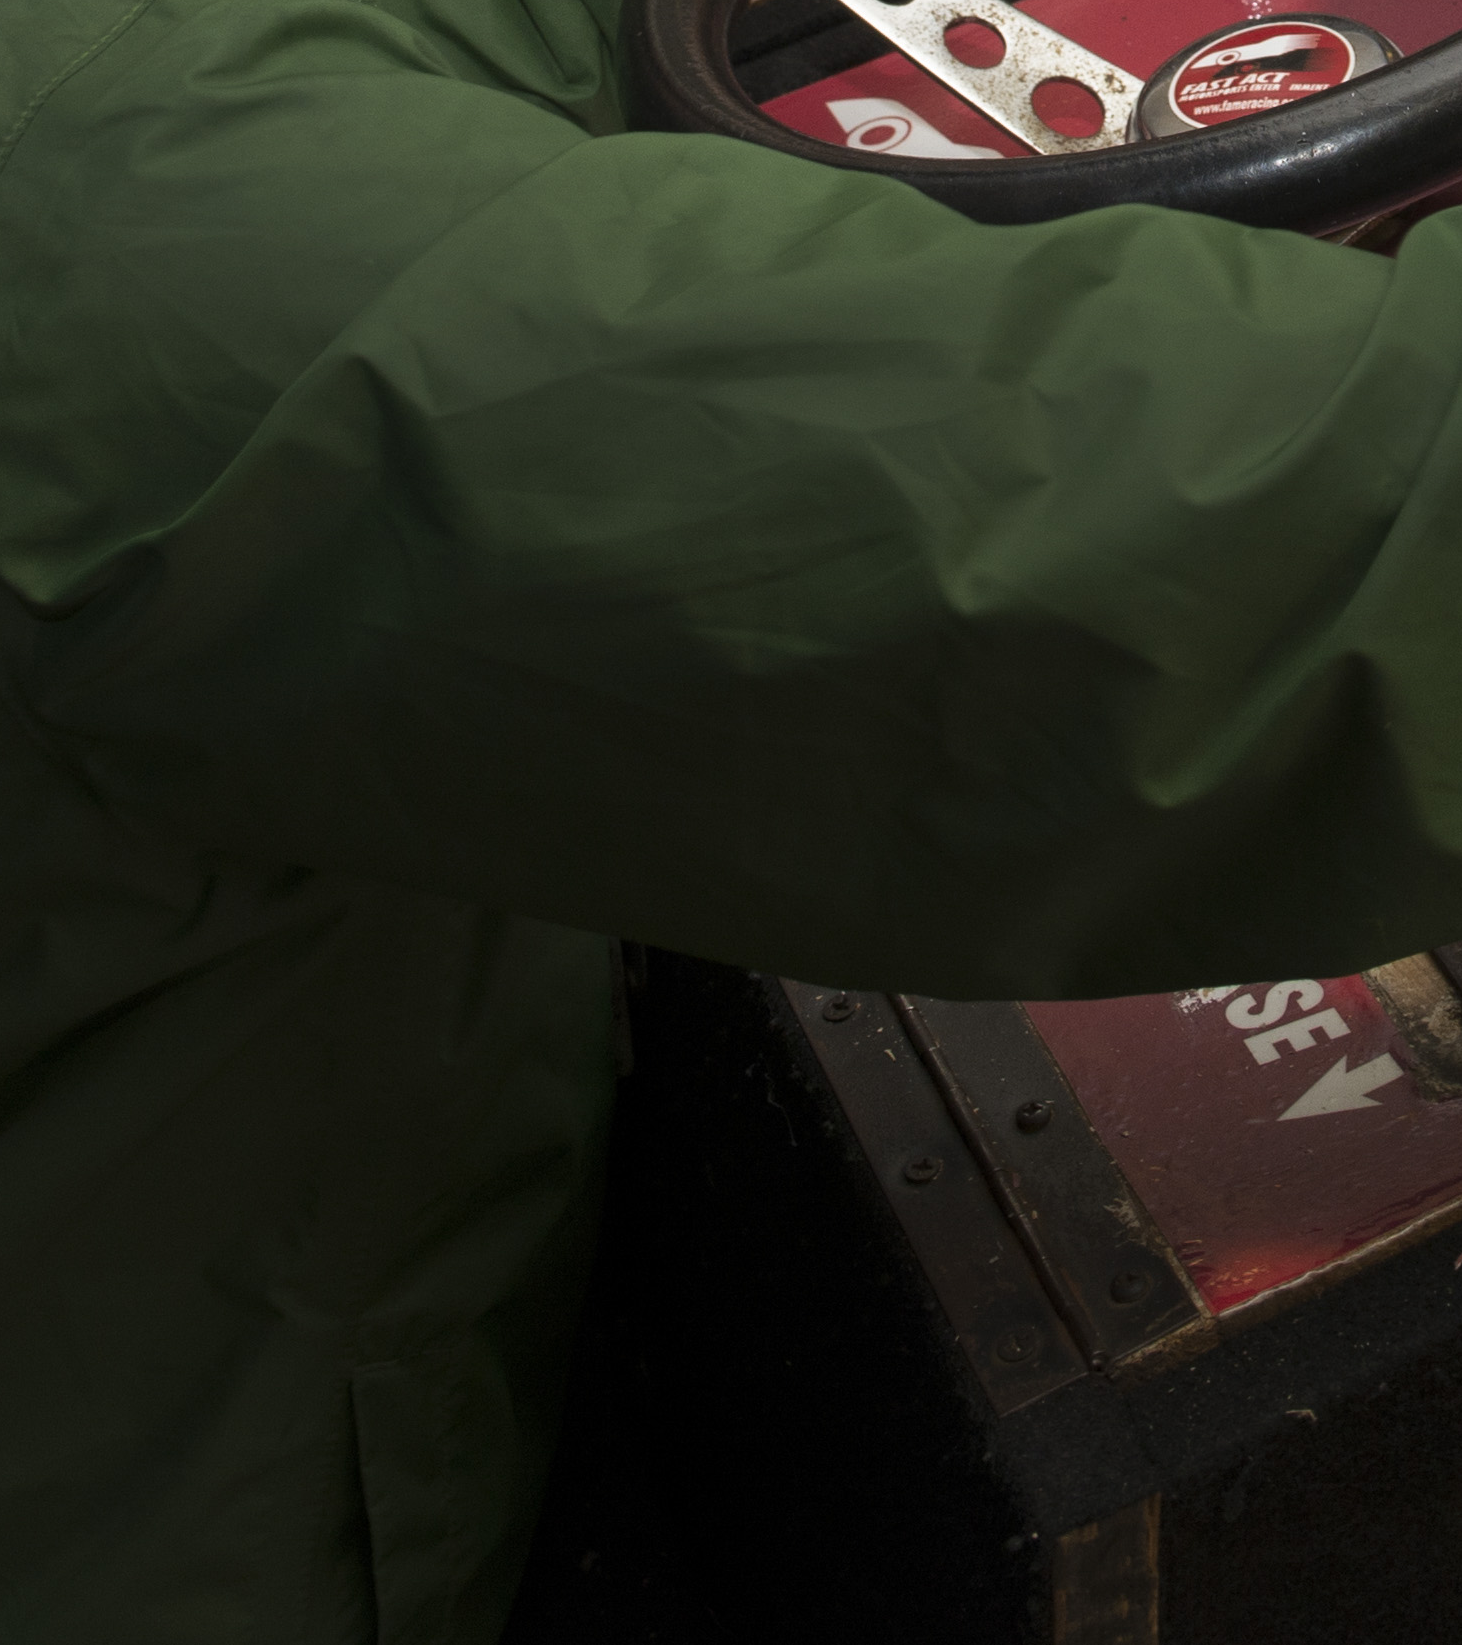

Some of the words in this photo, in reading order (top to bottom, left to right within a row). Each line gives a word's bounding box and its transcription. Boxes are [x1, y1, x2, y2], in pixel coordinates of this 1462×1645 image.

[1177, 84, 1247, 103] MOTORSPORTS
[1180, 76, 1239, 96] FAST
[1240, 72, 1290, 85] ACT
[1188, 977, 1352, 1066] SE
